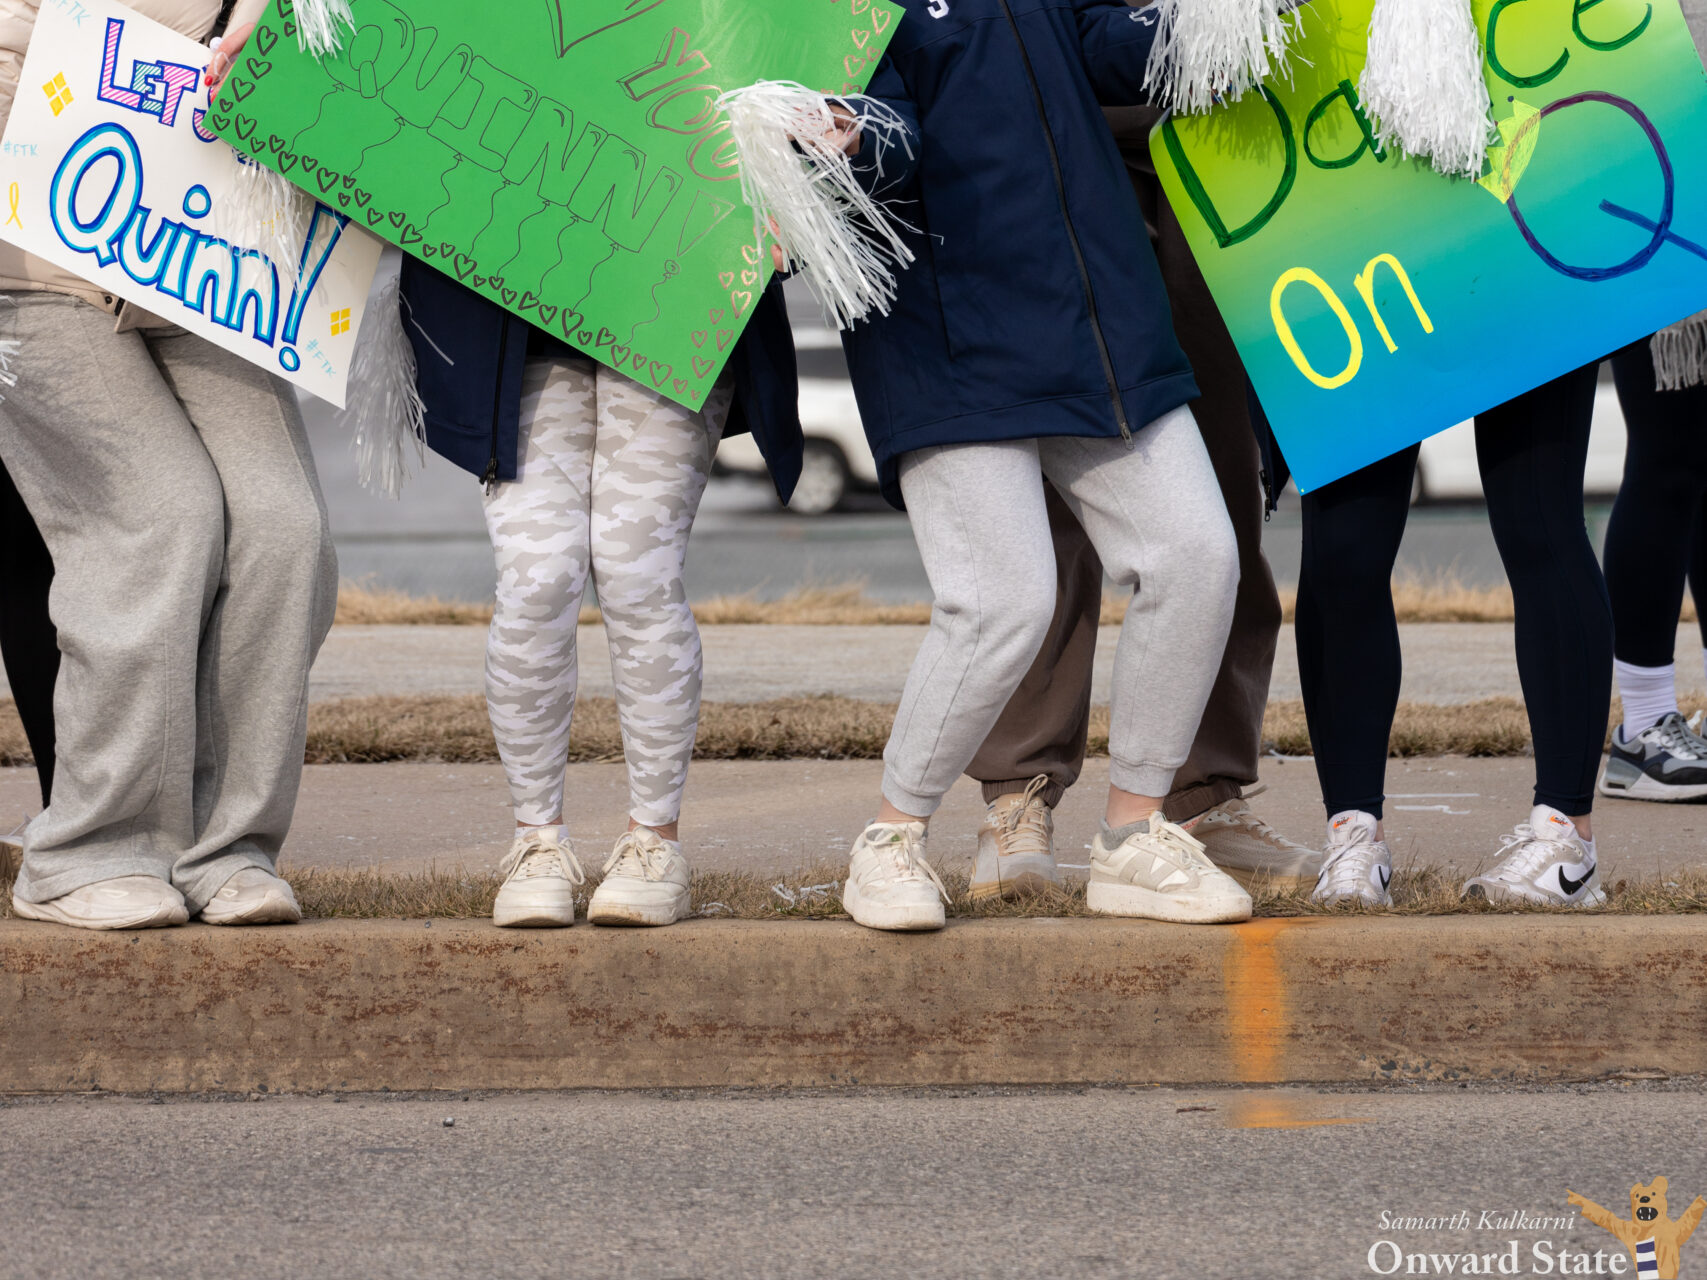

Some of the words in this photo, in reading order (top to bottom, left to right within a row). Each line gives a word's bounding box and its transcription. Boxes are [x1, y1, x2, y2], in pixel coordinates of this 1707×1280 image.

[3, 140, 39, 157] #FTK
[97, 17, 219, 143] LET
[49, 121, 353, 372] Quinn!
[1270, 253, 1434, 390] On
[1504, 90, 1707, 282] Q
